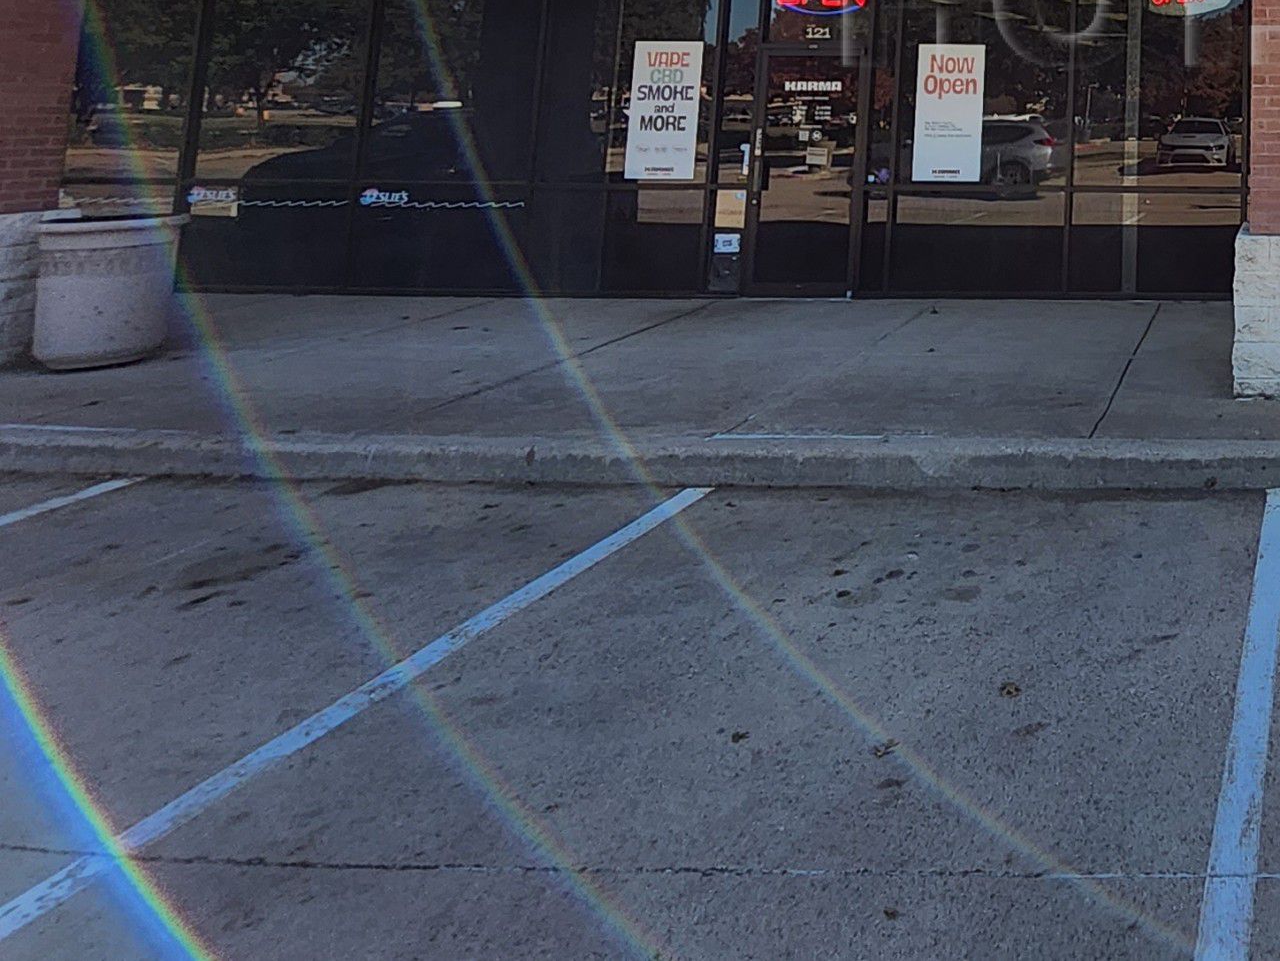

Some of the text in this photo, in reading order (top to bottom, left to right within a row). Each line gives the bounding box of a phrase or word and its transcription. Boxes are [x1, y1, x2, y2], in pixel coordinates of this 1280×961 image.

[805, 27, 831, 39] 121
[647, 51, 691, 68] VAPE
[929, 53, 975, 74] Now
[649, 68, 684, 84] CBD
[637, 84, 695, 101] SMOKE
[784, 81, 842, 91] KARMA
[923, 74, 978, 100] Open
[653, 103, 675, 114] and
[639, 115, 687, 131] MORE
